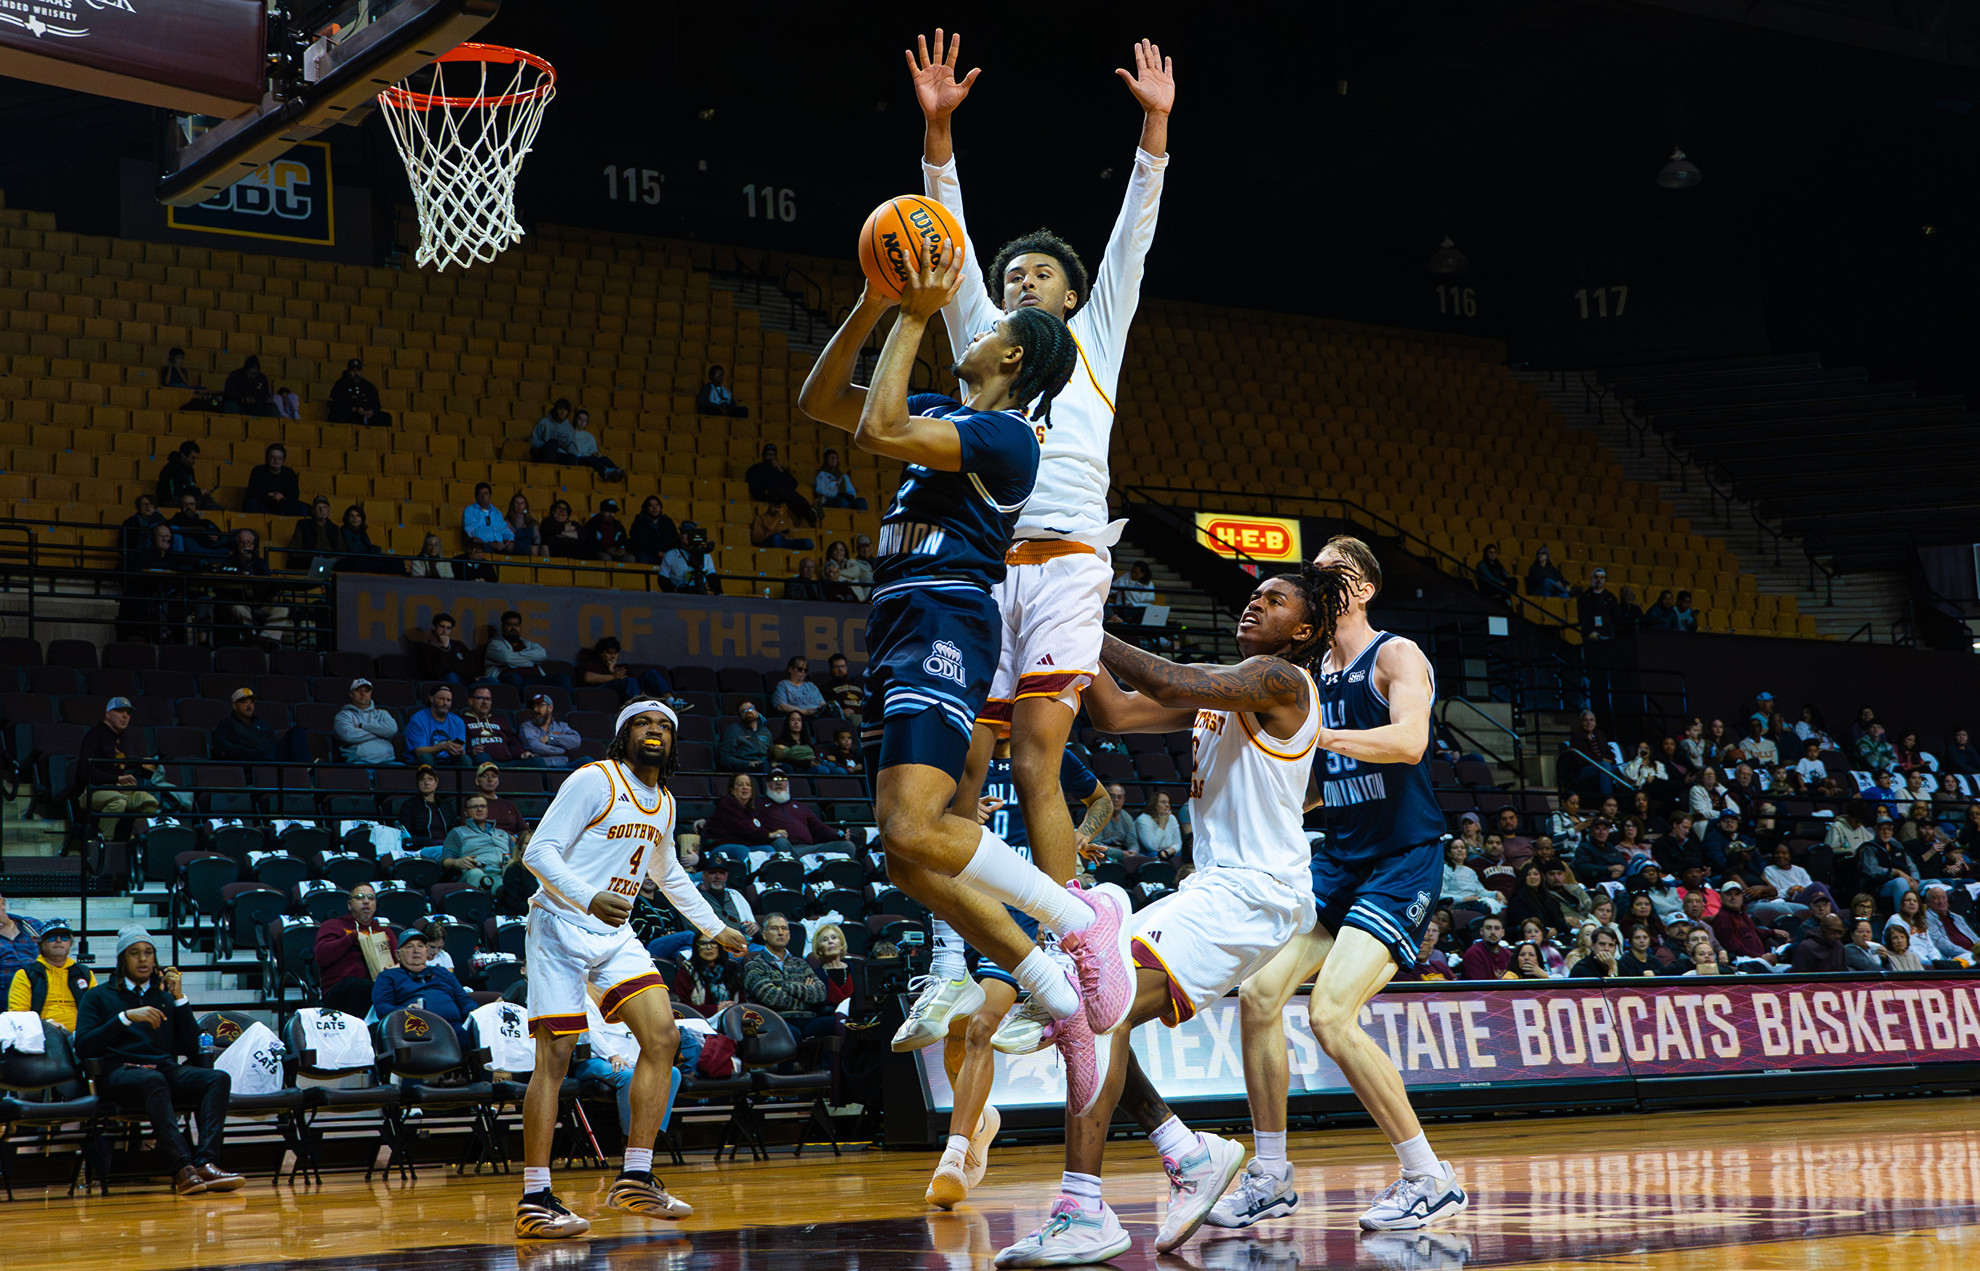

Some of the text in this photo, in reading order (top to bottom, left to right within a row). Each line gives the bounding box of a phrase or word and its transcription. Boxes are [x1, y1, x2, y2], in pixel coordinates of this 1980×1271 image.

[0, 1, 29, 12] NDED
[33, 6, 78, 21] WHISKEY
[603, 165, 662, 205] 115
[743, 183, 797, 223] 116
[1436, 284, 1477, 318] 116
[1574, 285, 1628, 319] 117
[357, 590, 551, 650] HOME
[577, 604, 653, 656] OF
[678, 609, 781, 659] THE
[924, 655, 966, 686] ODU
[606, 823, 663, 848] SOUTHWE
[629, 845, 646, 876] 4
[316, 1021, 346, 1031] CATS
[1143, 1004, 1320, 1081] TEXS
[1512, 993, 1742, 1067] BOBCATS
[1751, 987, 1980, 1057] BASKETBA
[253, 1050, 278, 1075] CATS
